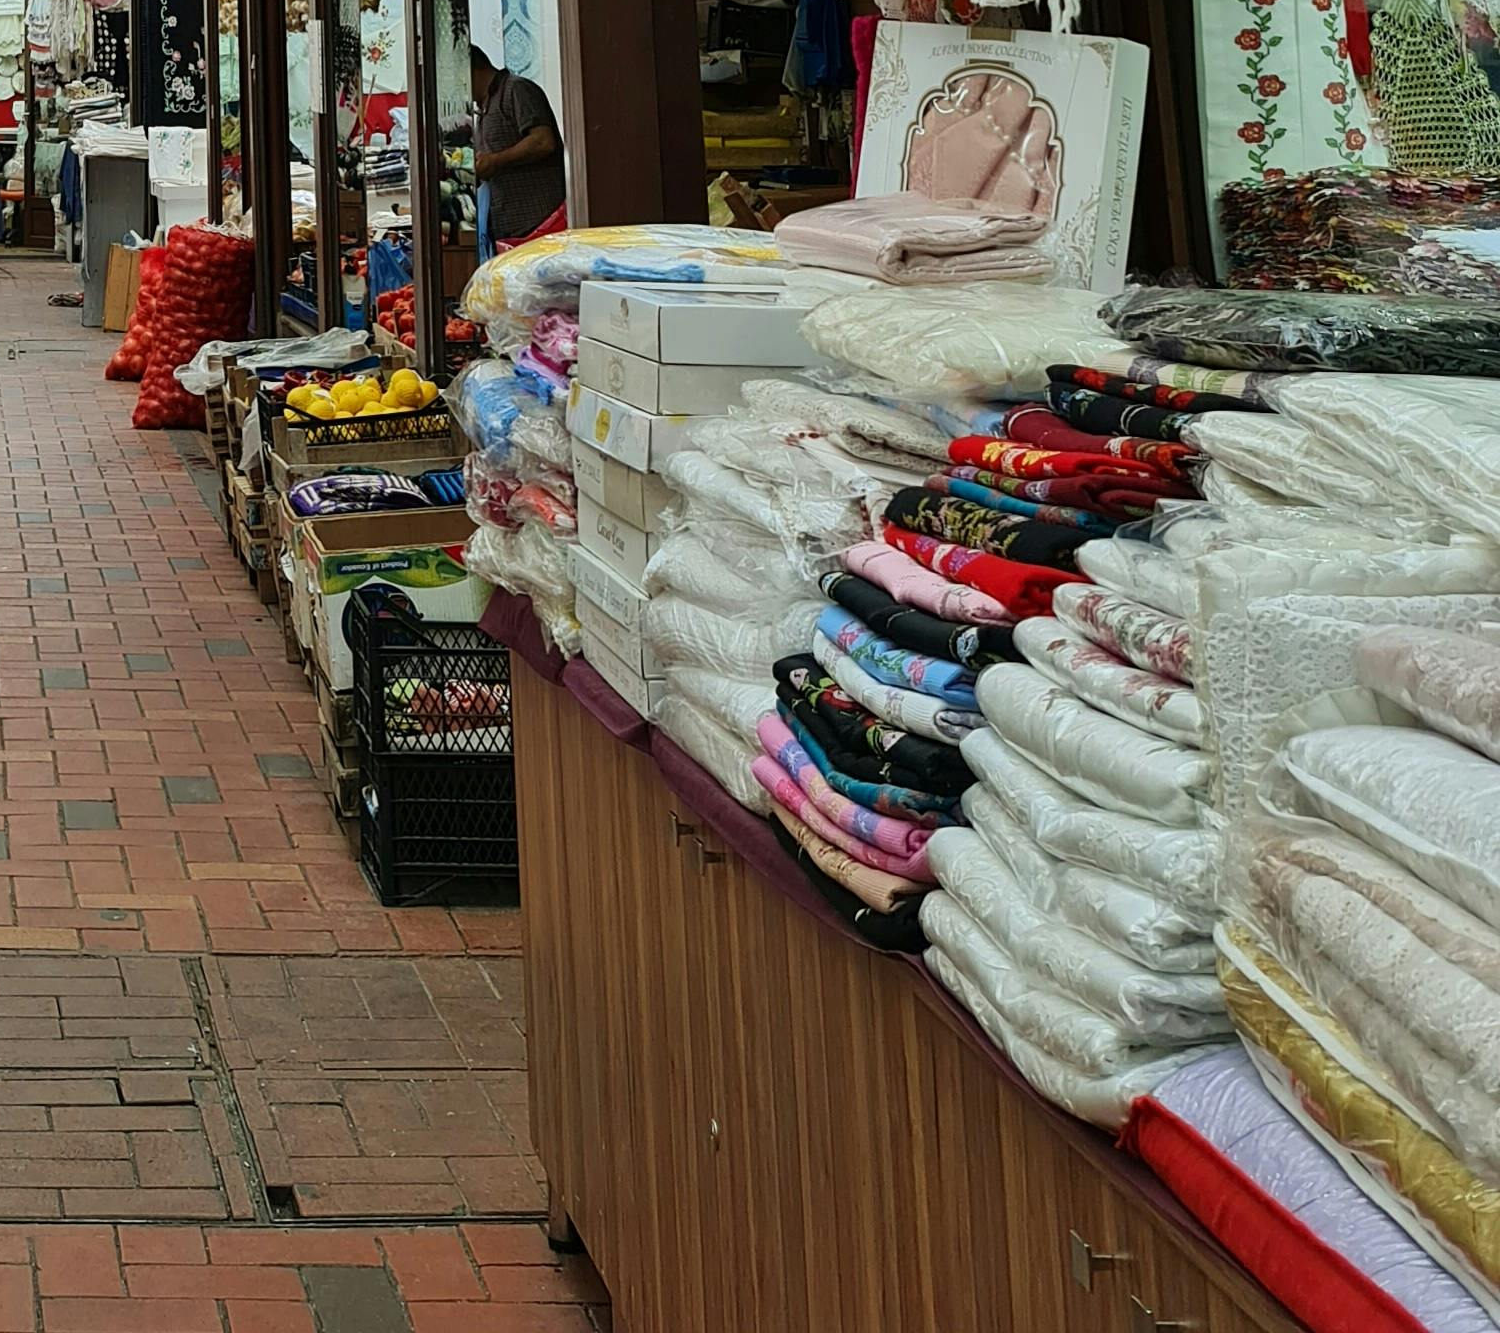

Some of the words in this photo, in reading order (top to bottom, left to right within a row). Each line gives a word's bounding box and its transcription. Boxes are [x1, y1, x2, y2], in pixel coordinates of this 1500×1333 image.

[341, 563, 371, 572] Ecuador
[372, 563, 380, 571] of
[381, 560, 409, 571] Product
